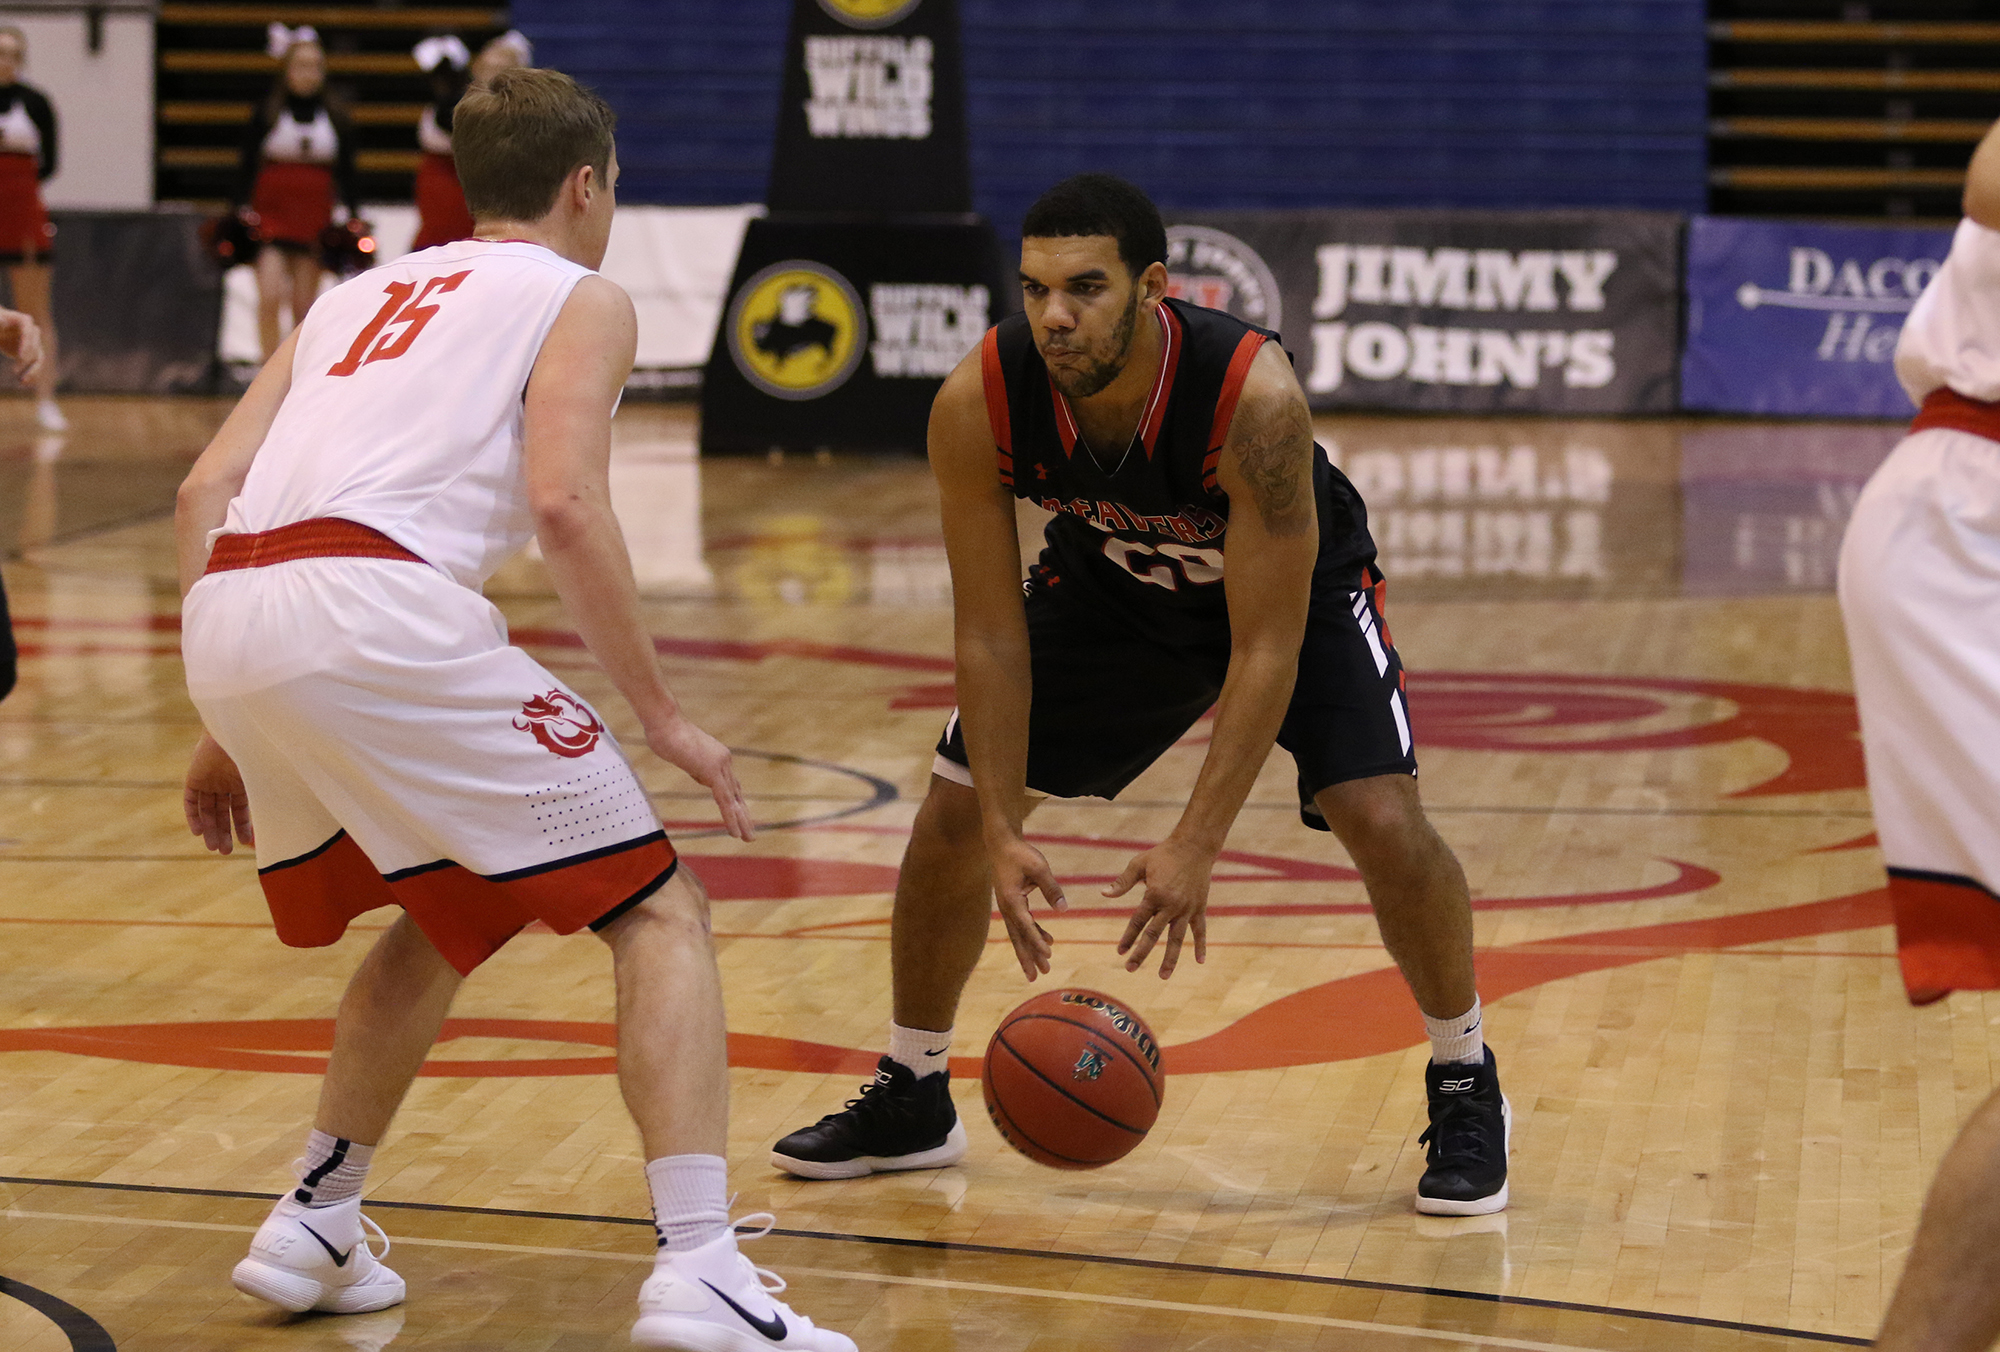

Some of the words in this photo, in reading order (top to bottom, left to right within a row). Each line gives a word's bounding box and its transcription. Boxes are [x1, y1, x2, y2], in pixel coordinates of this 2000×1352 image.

[1312, 243, 1617, 318] JIMMY
[325, 269, 475, 377] 15
[1308, 320, 1617, 394] JOHN'S
[870, 344, 966, 378] WING
[1061, 993, 1160, 1075] Wilson
